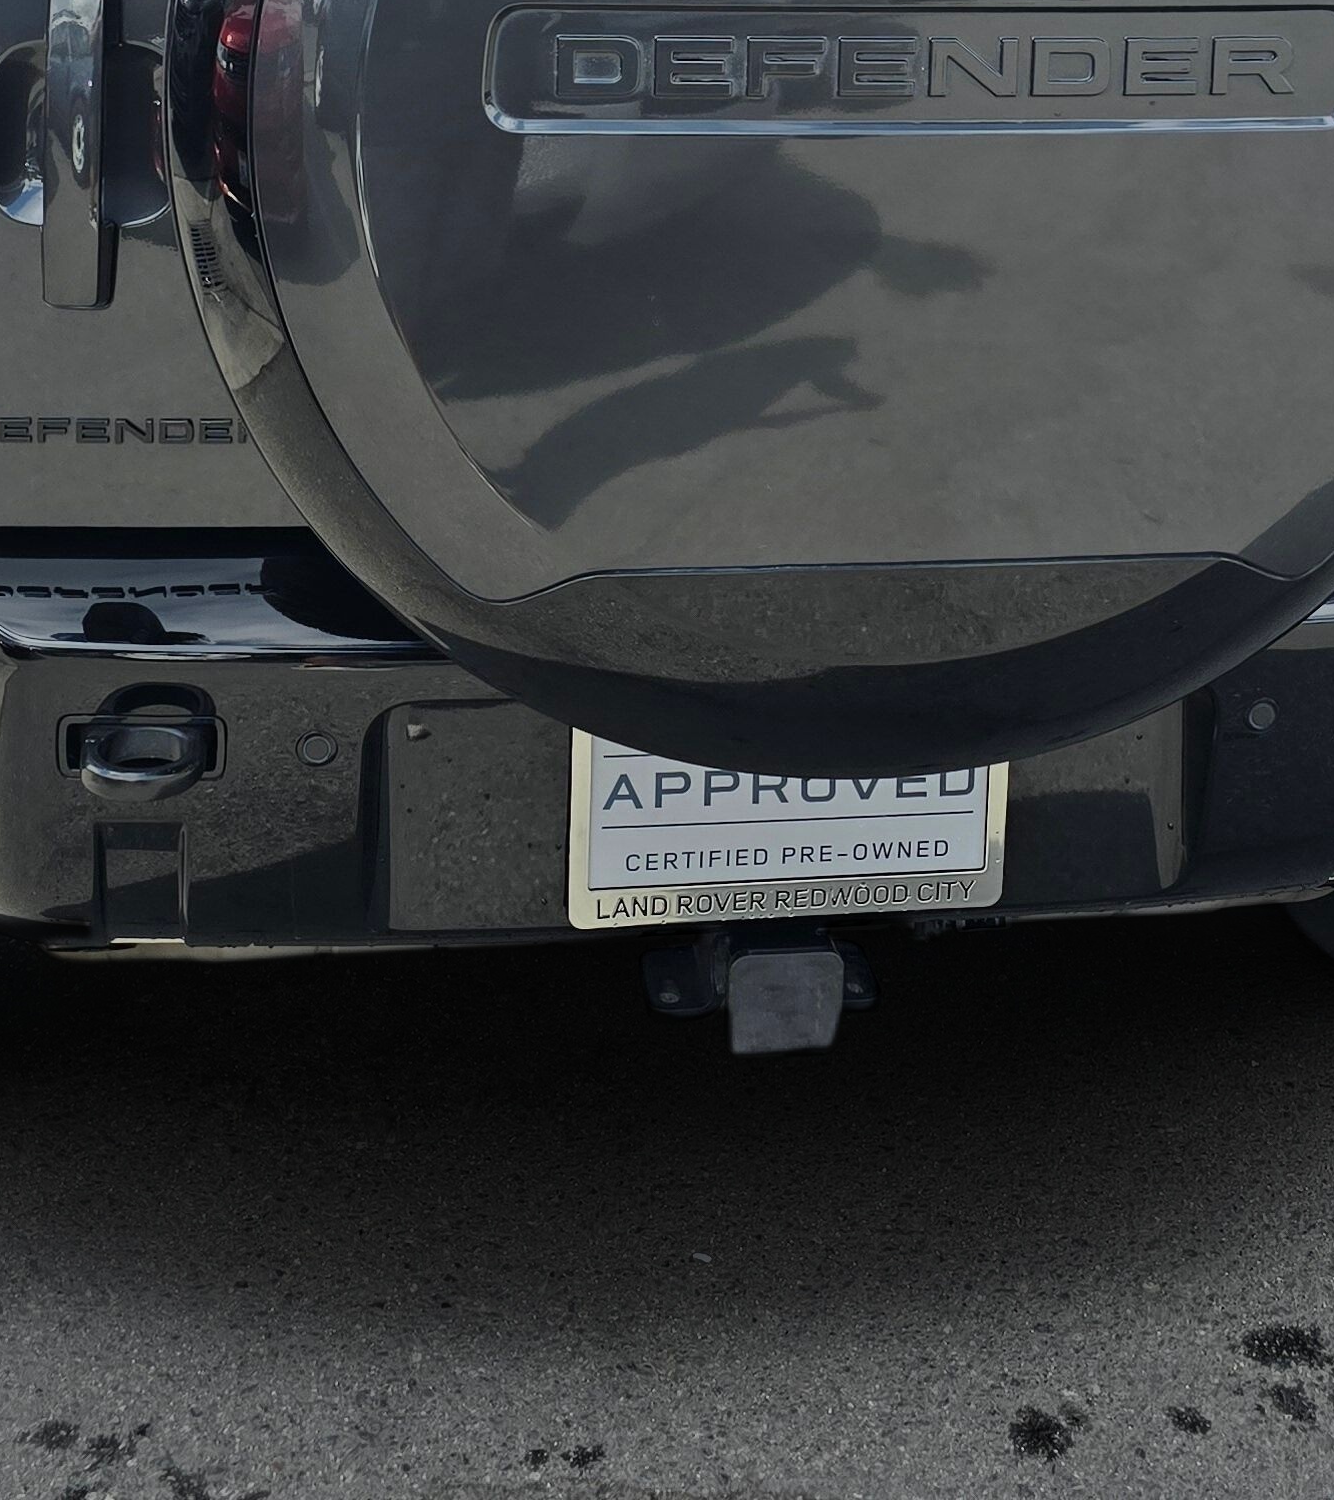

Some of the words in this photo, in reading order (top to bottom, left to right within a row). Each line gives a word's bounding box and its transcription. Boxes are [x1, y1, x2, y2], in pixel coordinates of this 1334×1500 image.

[555, 33, 1296, 99] DEFENDER
[603, 766, 975, 810] APPROVED
[624, 847, 768, 872] CERTIFIED
[780, 839, 949, 866] PRE-OWNED
[596, 894, 668, 920] LAND
[676, 890, 766, 916] ROVER
[778, 882, 908, 911] REDWOOD
[917, 880, 976, 903] CITY
